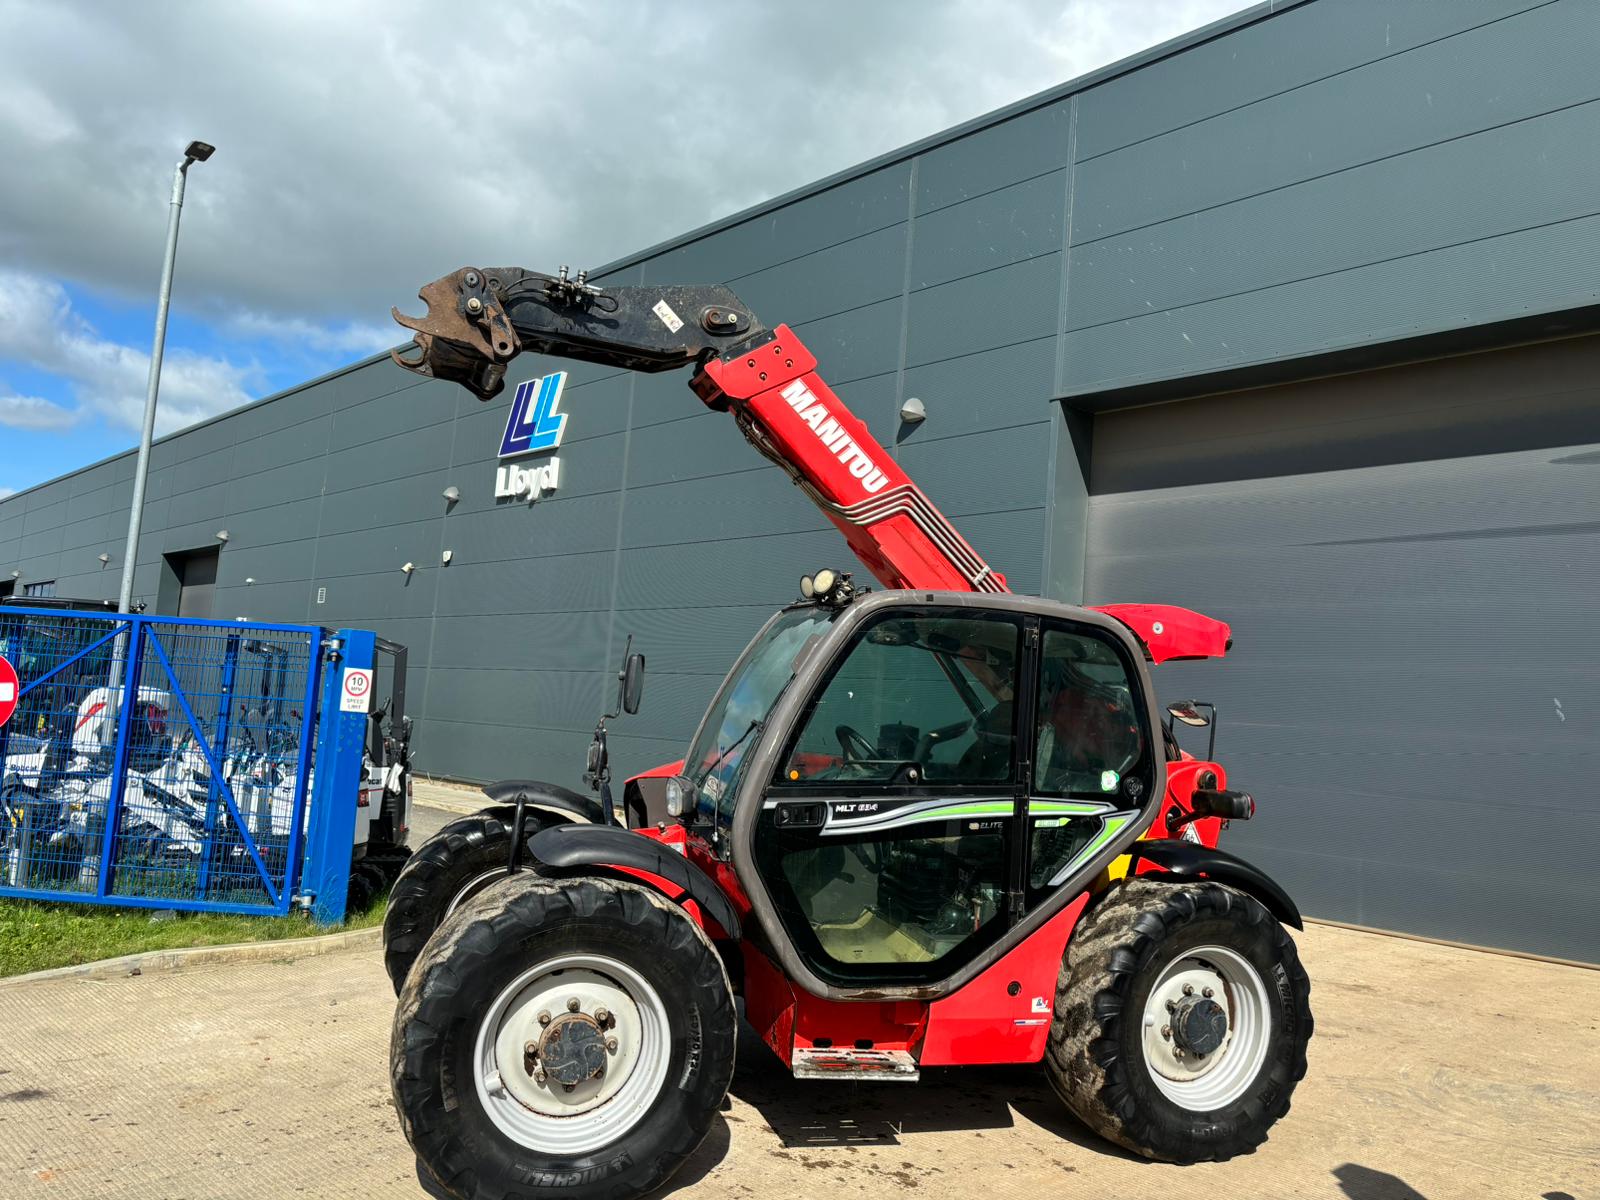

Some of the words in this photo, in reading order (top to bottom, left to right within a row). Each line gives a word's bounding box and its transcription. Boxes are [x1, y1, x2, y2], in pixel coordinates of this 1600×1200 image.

[779, 378, 890, 493] MANITOU
[495, 457, 560, 500] Lloyd
[351, 677, 364, 686] 10
[835, 804, 856, 812] MLT
[980, 821, 1003, 829] ELITE
